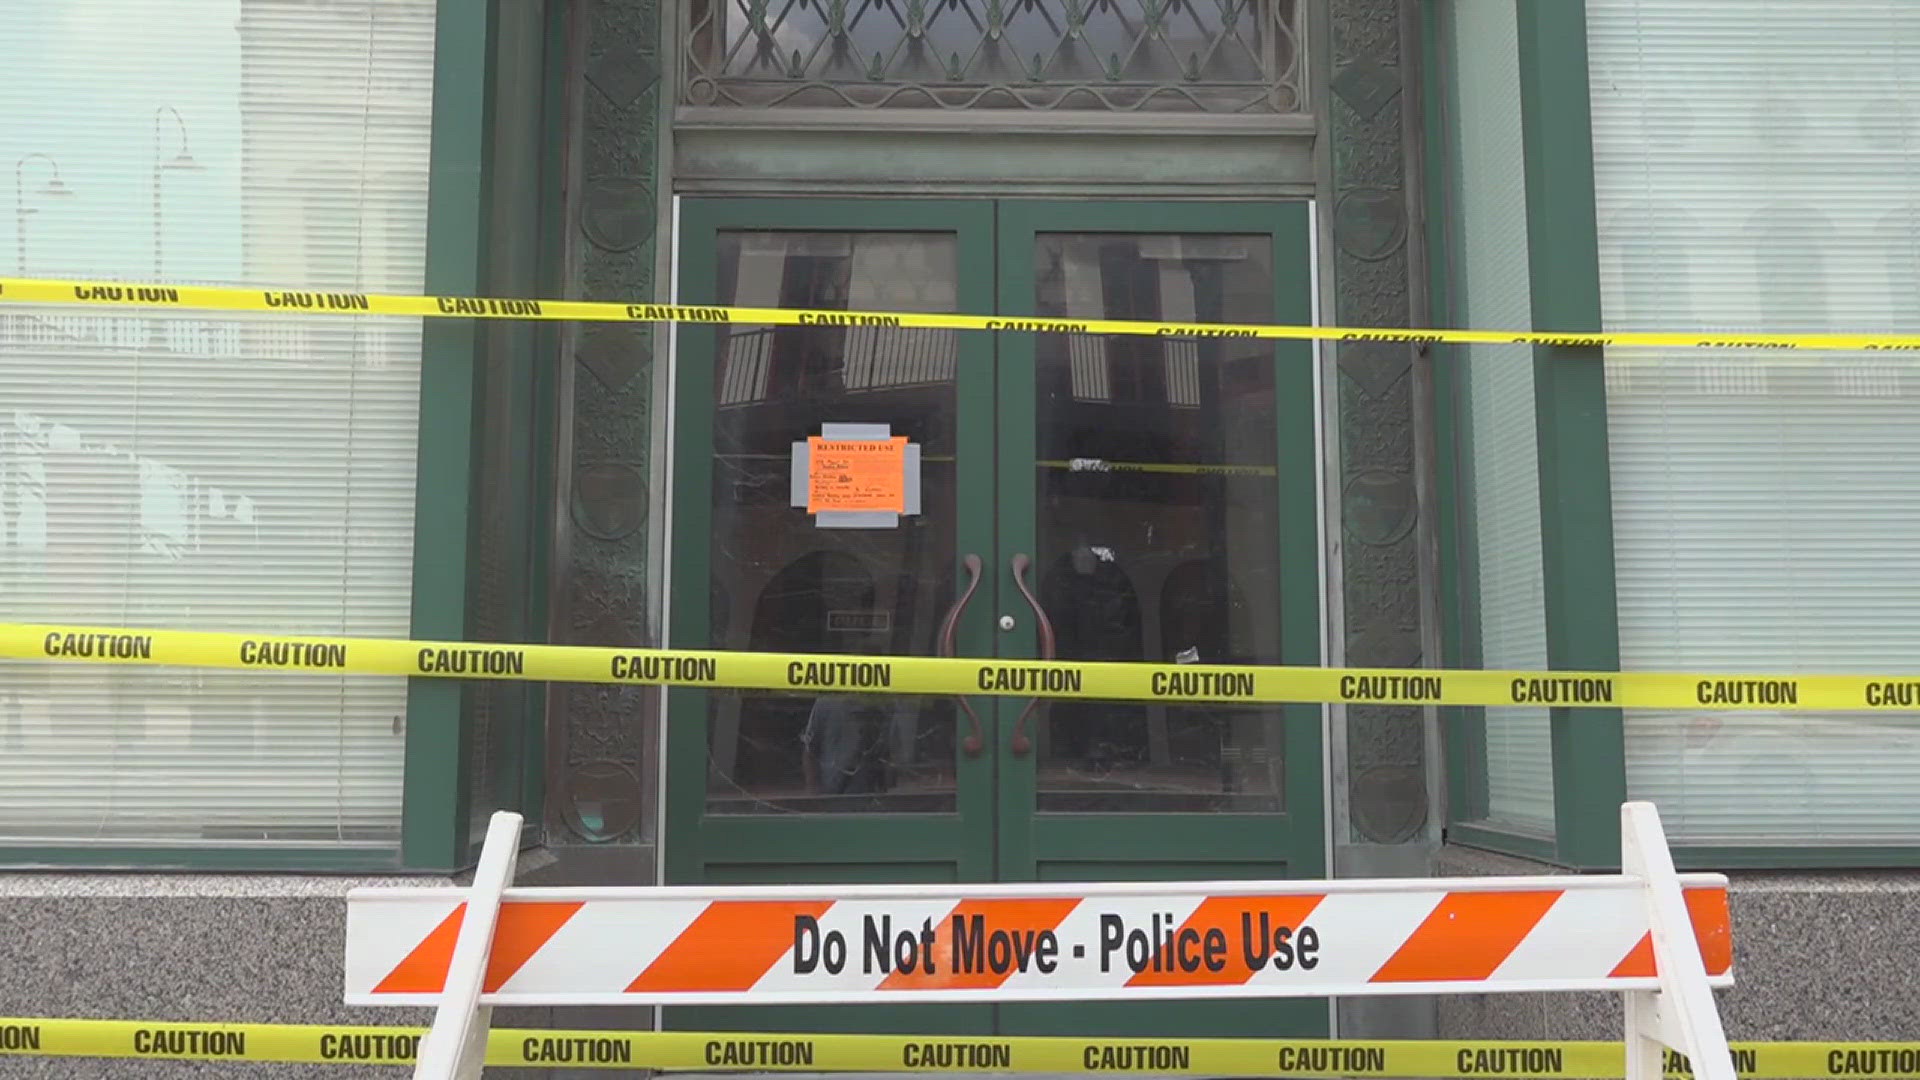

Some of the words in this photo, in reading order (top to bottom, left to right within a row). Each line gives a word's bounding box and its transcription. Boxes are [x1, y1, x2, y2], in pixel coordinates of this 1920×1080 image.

[75, 287, 179, 302] CAUTION
[265, 291, 369, 309] CAUTION
[437, 297, 541, 315] CAUTION
[627, 305, 729, 321] CAUTION
[798, 312, 900, 326] CAUTION
[986, 320, 1087, 332] CAUTION
[45, 633, 151, 659] CAUTION
[241, 640, 346, 667] CAUTION
[418, 648, 523, 675] CAUTION
[611, 656, 716, 682] CAUTION
[787, 662, 891, 687] CAUTION
[978, 667, 1081, 692] CAUTION
[1152, 671, 1254, 696] CAUTION
[1341, 676, 1442, 701] CAUTION
[1511, 679, 1612, 704] CAUTION
[1697, 681, 1797, 705] CAUTION
[794, 915, 847, 975] Do
[864, 915, 936, 975] Not
[953, 915, 1058, 975] Move
[1101, 913, 1227, 974] Police
[1243, 912, 1320, 972] Use
[134, 1030, 246, 1056] CAUTION
[523, 1038, 632, 1063] CAUTION
[705, 1041, 814, 1066] CAUTION
[904, 1044, 1011, 1069] CAUTION
[1084, 1046, 1190, 1070] CAUTION
[1279, 1047, 1385, 1072] CAUTION
[1457, 1049, 1562, 1073] CAUTION
[1828, 1049, 1920, 1075] CAUTIO
